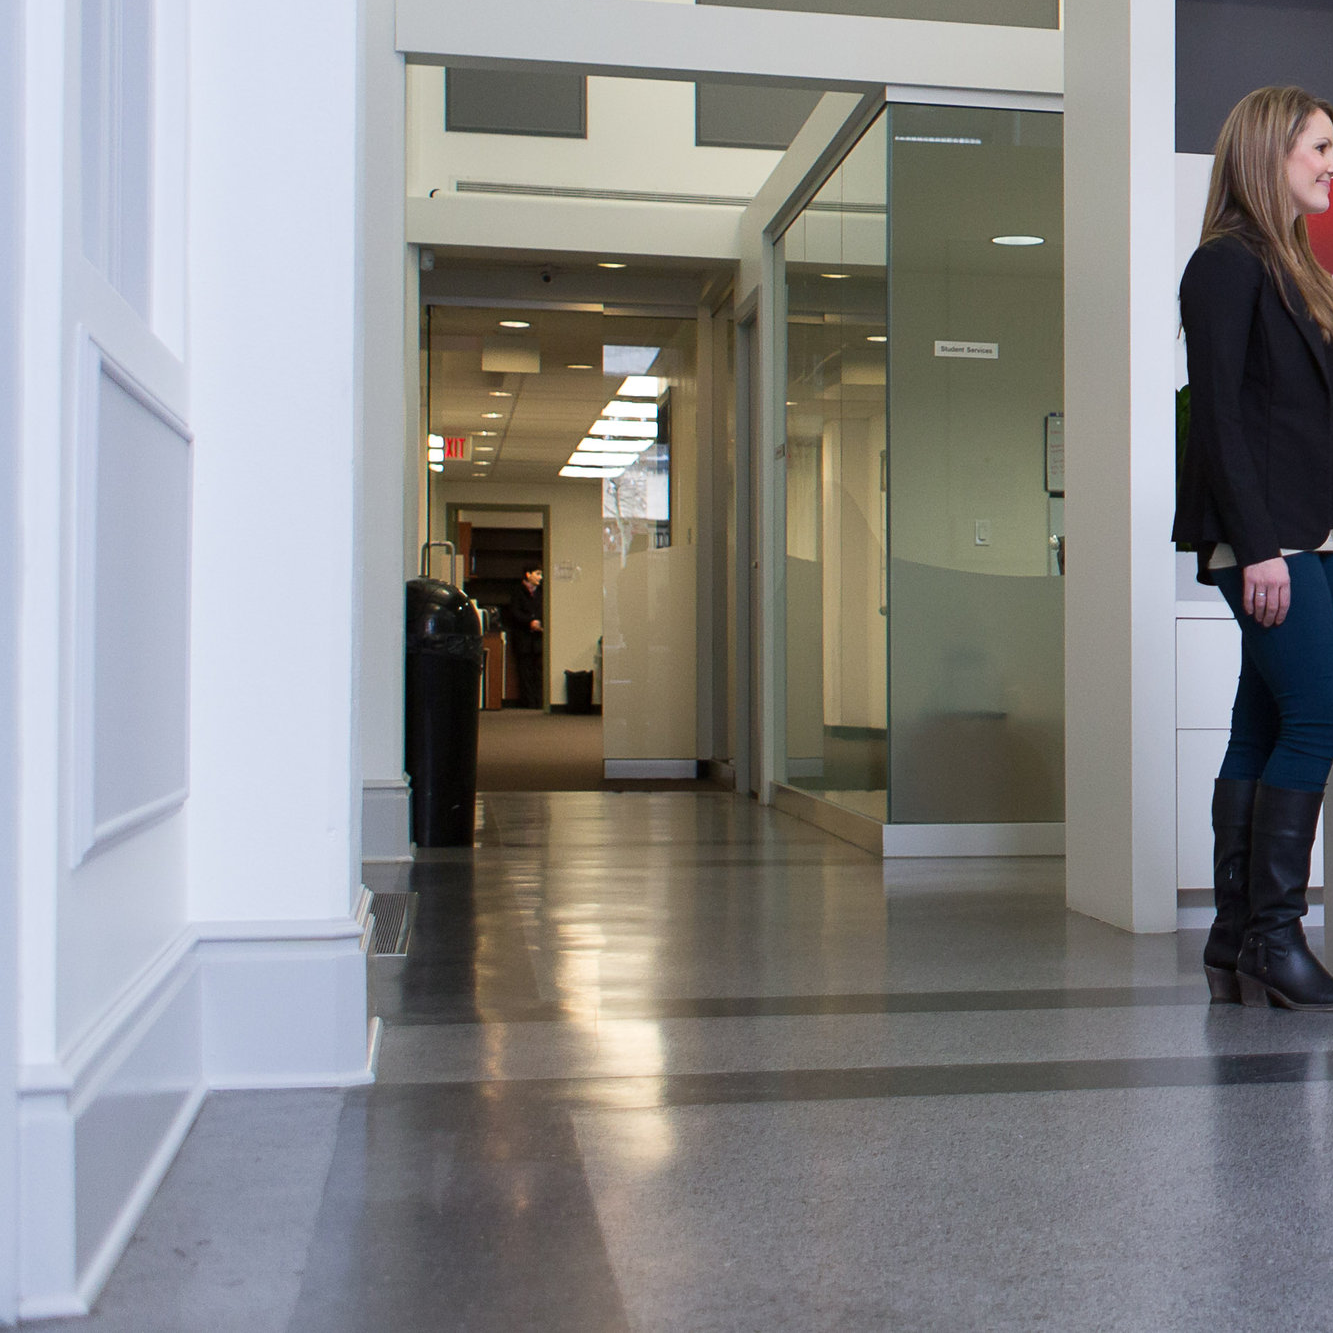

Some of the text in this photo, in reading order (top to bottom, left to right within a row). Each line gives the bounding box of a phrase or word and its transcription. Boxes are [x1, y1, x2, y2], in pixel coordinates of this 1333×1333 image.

[940, 345, 993, 355] Student Services
[444, 437, 466, 459] XIT
